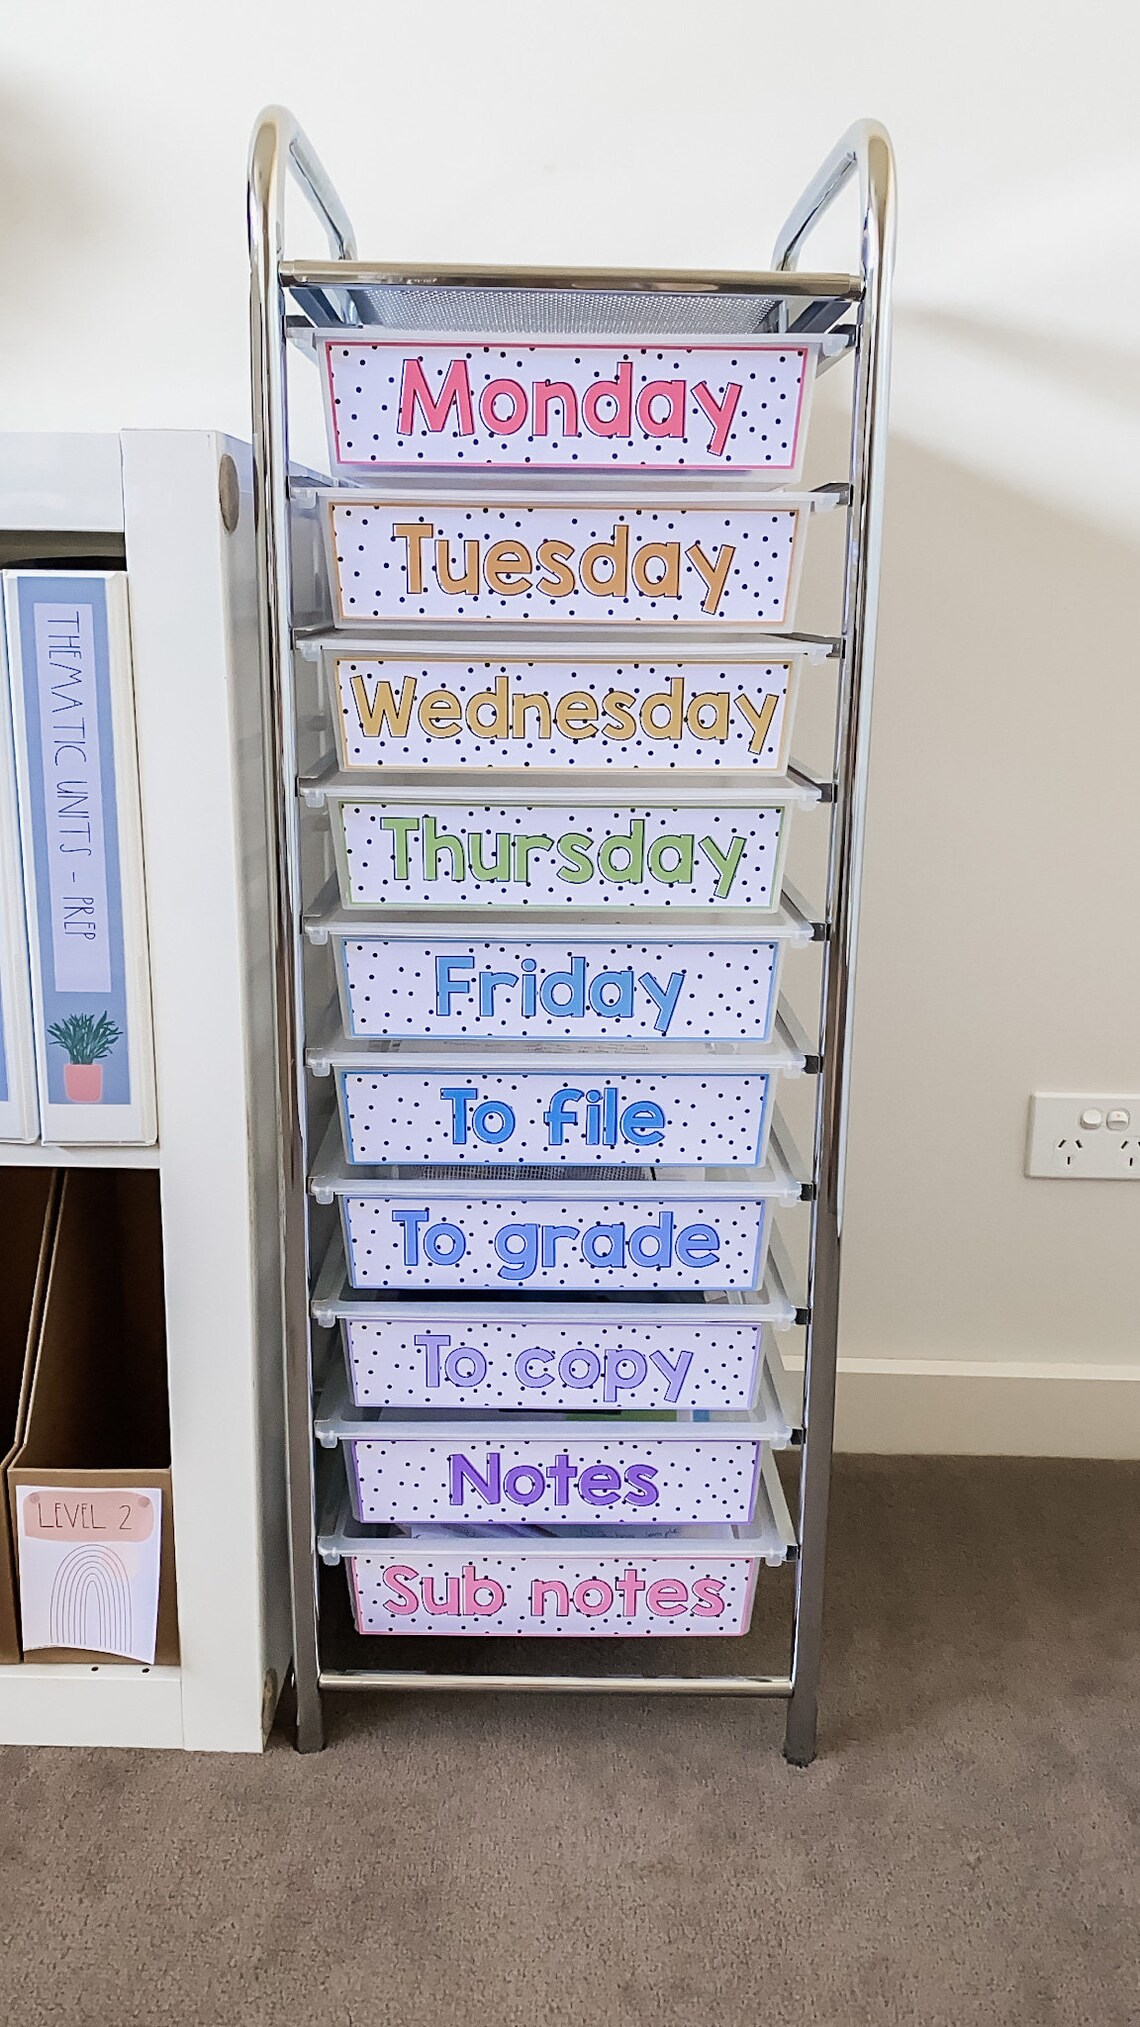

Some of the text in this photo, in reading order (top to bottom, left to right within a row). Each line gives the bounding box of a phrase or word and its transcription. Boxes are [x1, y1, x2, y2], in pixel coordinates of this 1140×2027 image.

[396, 357, 743, 457] Monday
[392, 522, 737, 616] Tuesday
[47, 611, 87, 766] THEMATIC
[348, 675, 780, 756] Wednesday
[56, 780, 92, 857] UNITS
[379, 816, 748, 899] Thursday
[62, 896, 97, 941] PREP
[433, 954, 686, 1033] Friday
[439, 1086, 667, 1146] To file
[391, 1209, 722, 1280] To grade
[413, 1333, 695, 1404] To copy
[37, 1501, 133, 1531] LEVEL 2
[448, 1452, 661, 1508] Notes
[381, 1564, 728, 1620] Sub notes
